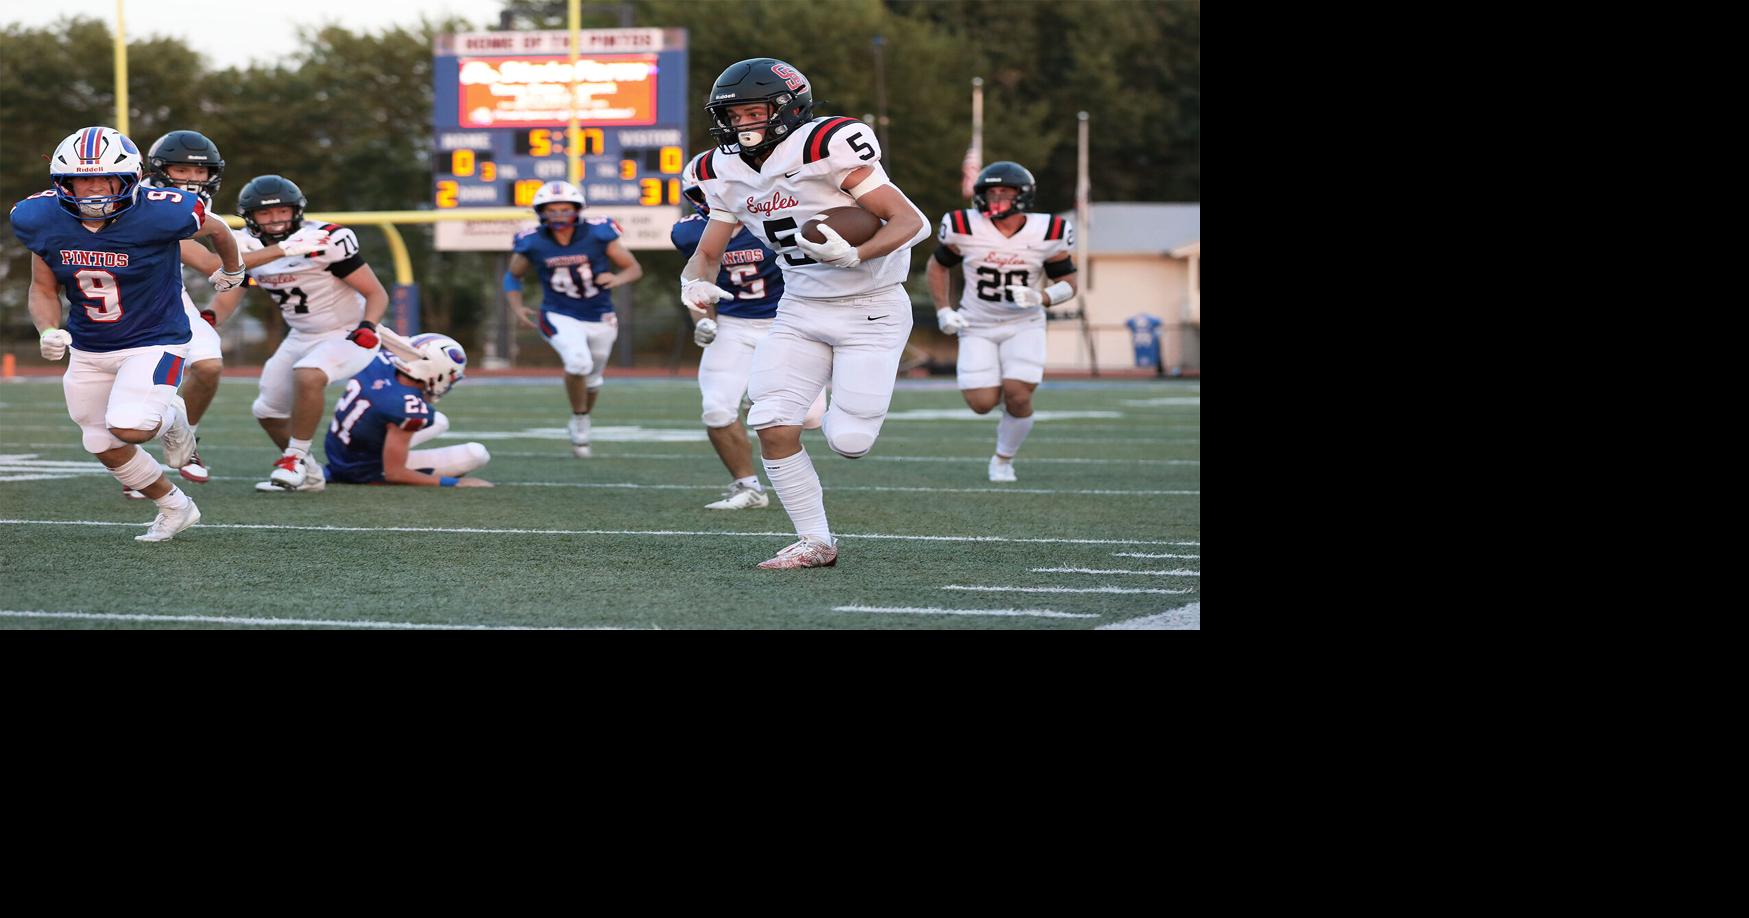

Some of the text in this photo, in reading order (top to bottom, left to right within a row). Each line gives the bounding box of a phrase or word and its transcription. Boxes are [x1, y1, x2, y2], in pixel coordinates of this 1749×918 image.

[659, 146, 683, 175] 0
[846, 131, 876, 161] 5
[451, 149, 475, 177] 0
[480, 161, 497, 183] 3
[619, 159, 637, 181] 3
[435, 180, 459, 209] 2
[639, 177, 681, 207] 31
[746, 191, 799, 216] Eagles
[334, 234, 359, 257] 71
[762, 216, 819, 267] 5
[59, 249, 129, 268] PINTOS
[550, 263, 599, 299] 41
[725, 264, 767, 300] 5
[976, 265, 1030, 303] 20
[75, 269, 123, 323] 9
[330, 378, 372, 446] 21
[403, 394, 429, 415] 21
